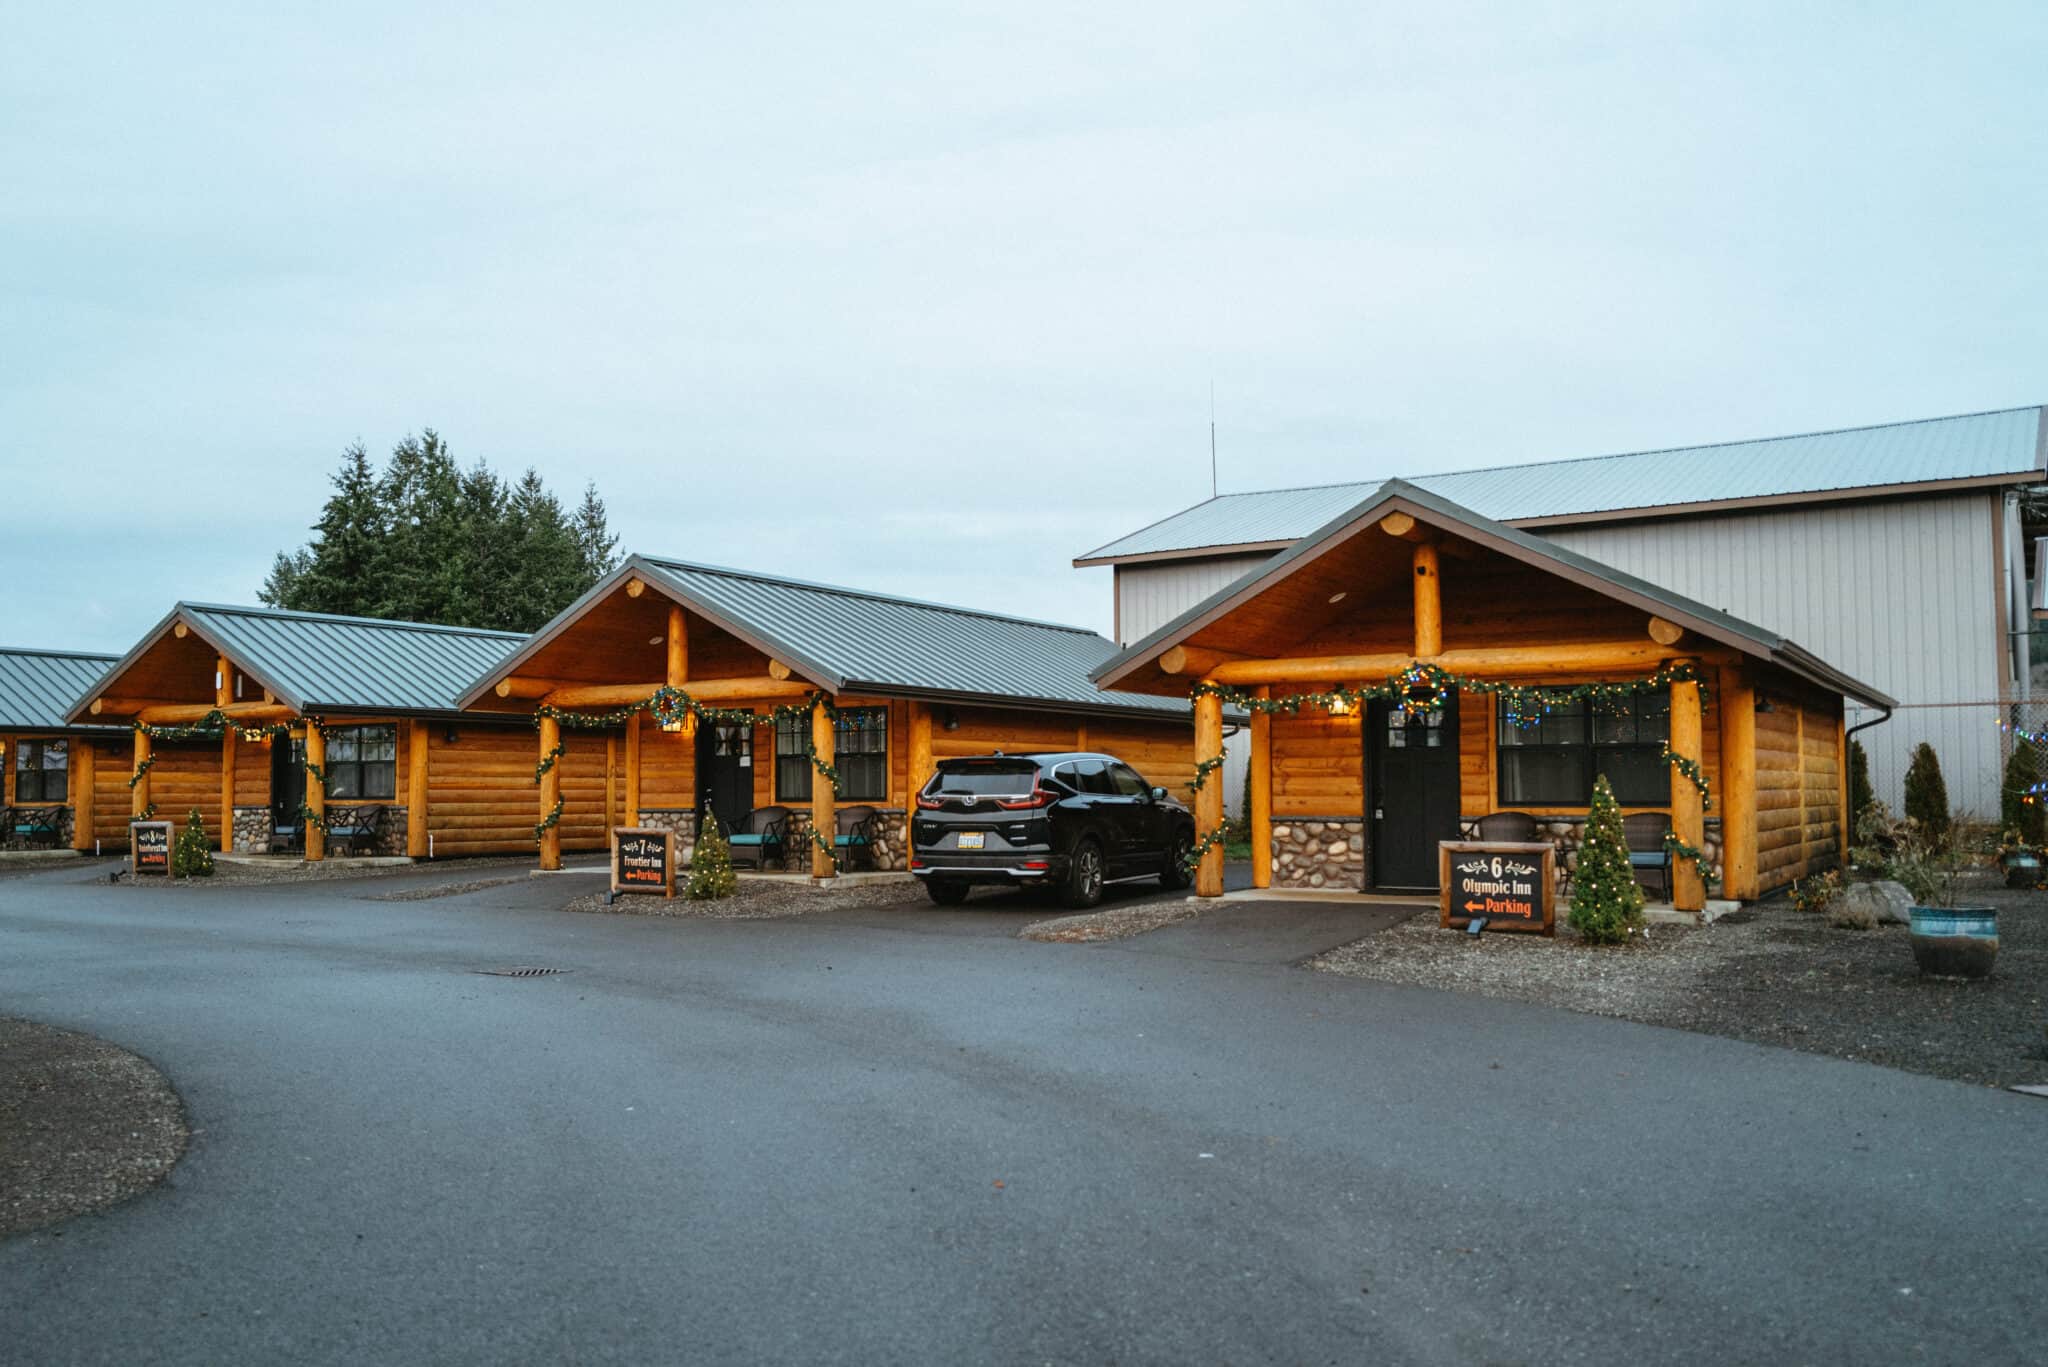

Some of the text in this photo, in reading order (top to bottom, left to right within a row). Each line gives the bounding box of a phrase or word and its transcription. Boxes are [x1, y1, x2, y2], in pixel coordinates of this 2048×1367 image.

[150, 830, 156, 843] 8
[640, 839, 646, 855] 7
[624, 855, 662, 868] Frontier Inn
[1491, 857, 1503, 878] 6
[636, 869, 662, 884] Parking
[1462, 879, 1532, 896] Olympic Inn
[1486, 898, 1532, 918] Parking
